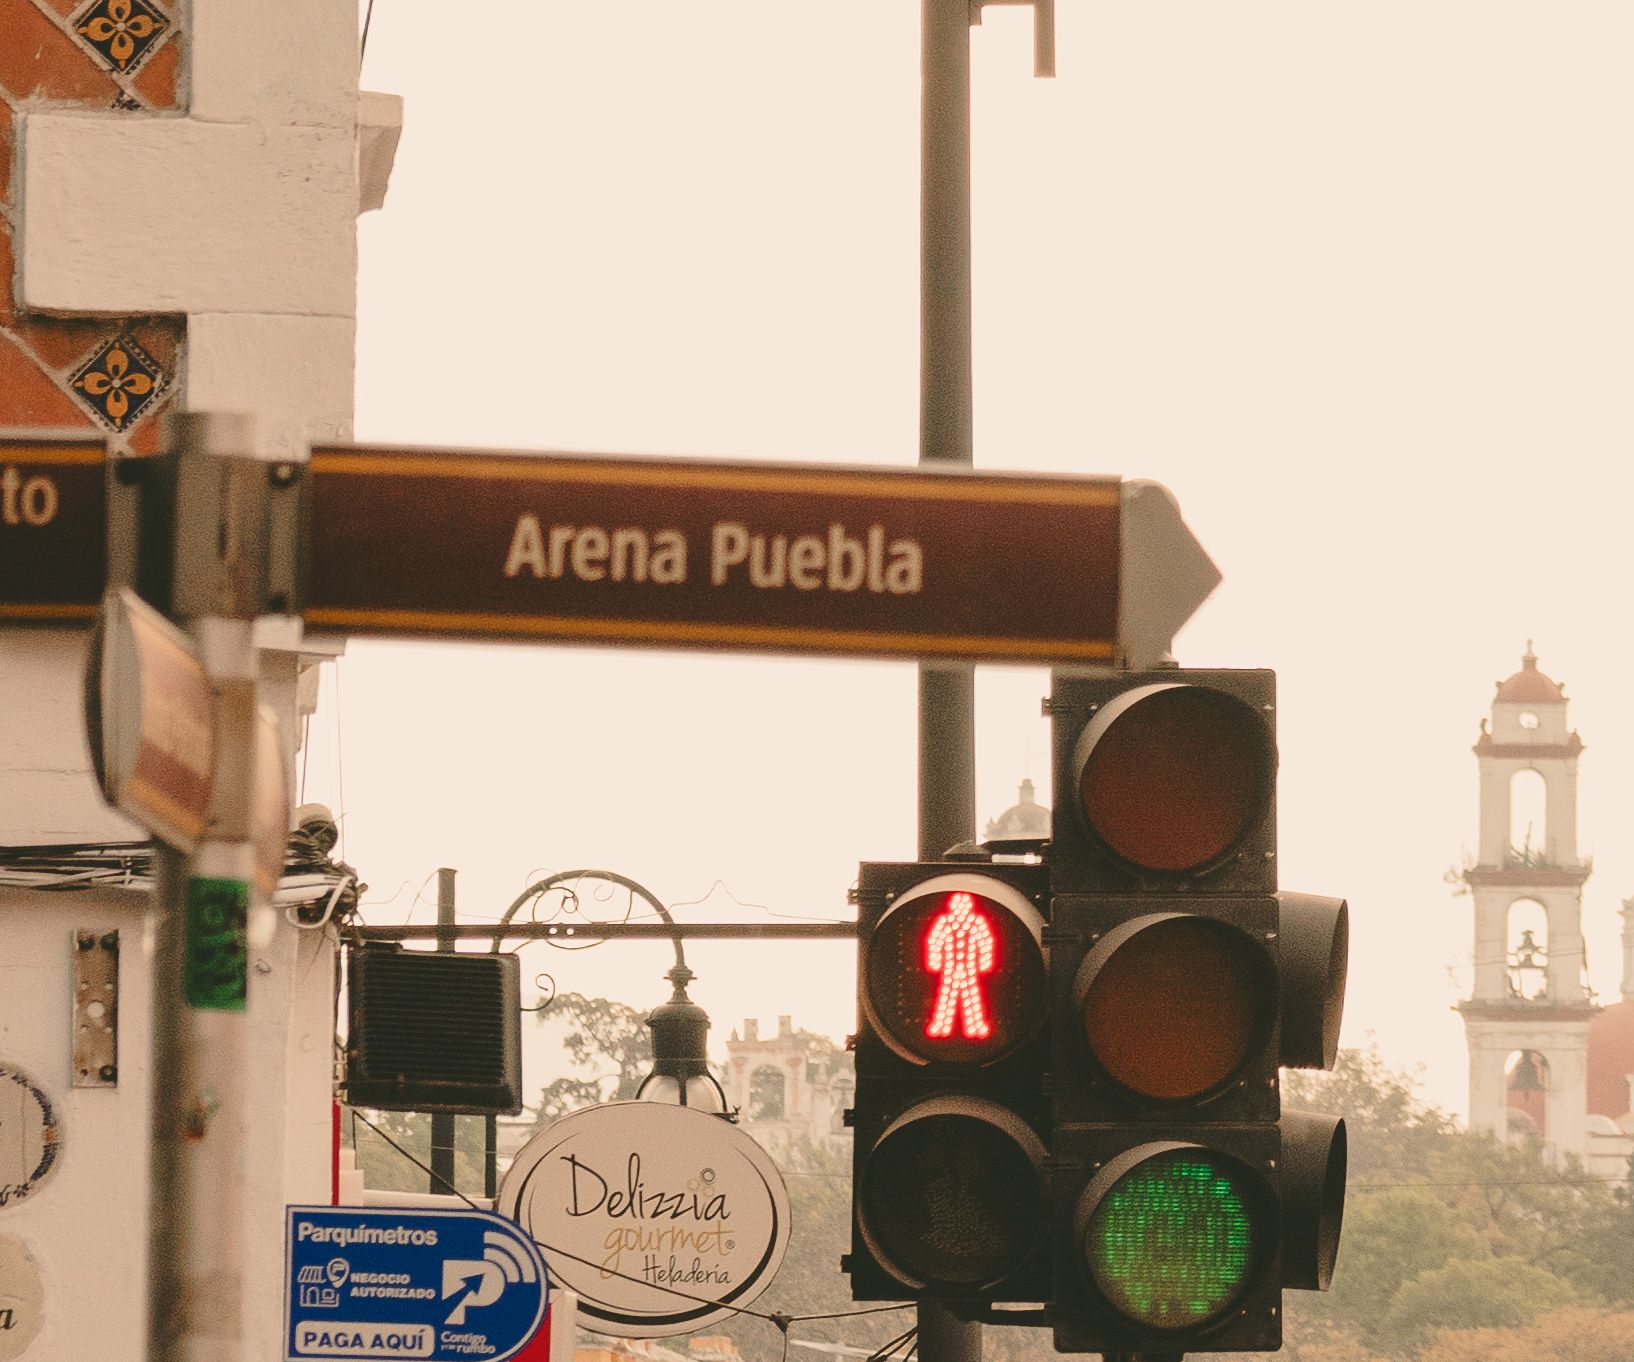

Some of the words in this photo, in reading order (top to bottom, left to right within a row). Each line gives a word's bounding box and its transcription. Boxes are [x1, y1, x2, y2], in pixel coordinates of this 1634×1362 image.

[503, 513, 688, 586] Arena
[708, 521, 924, 597] Puebla
[560, 1152, 731, 1221] Delizzia
[298, 1222, 438, 1248] Parquímetros
[350, 1272, 411, 1285] NEGOCIO
[350, 1287, 436, 1300] AUTORIZADO
[304, 1331, 365, 1348] PAGA
[370, 1329, 425, 1351] AQUÍ
